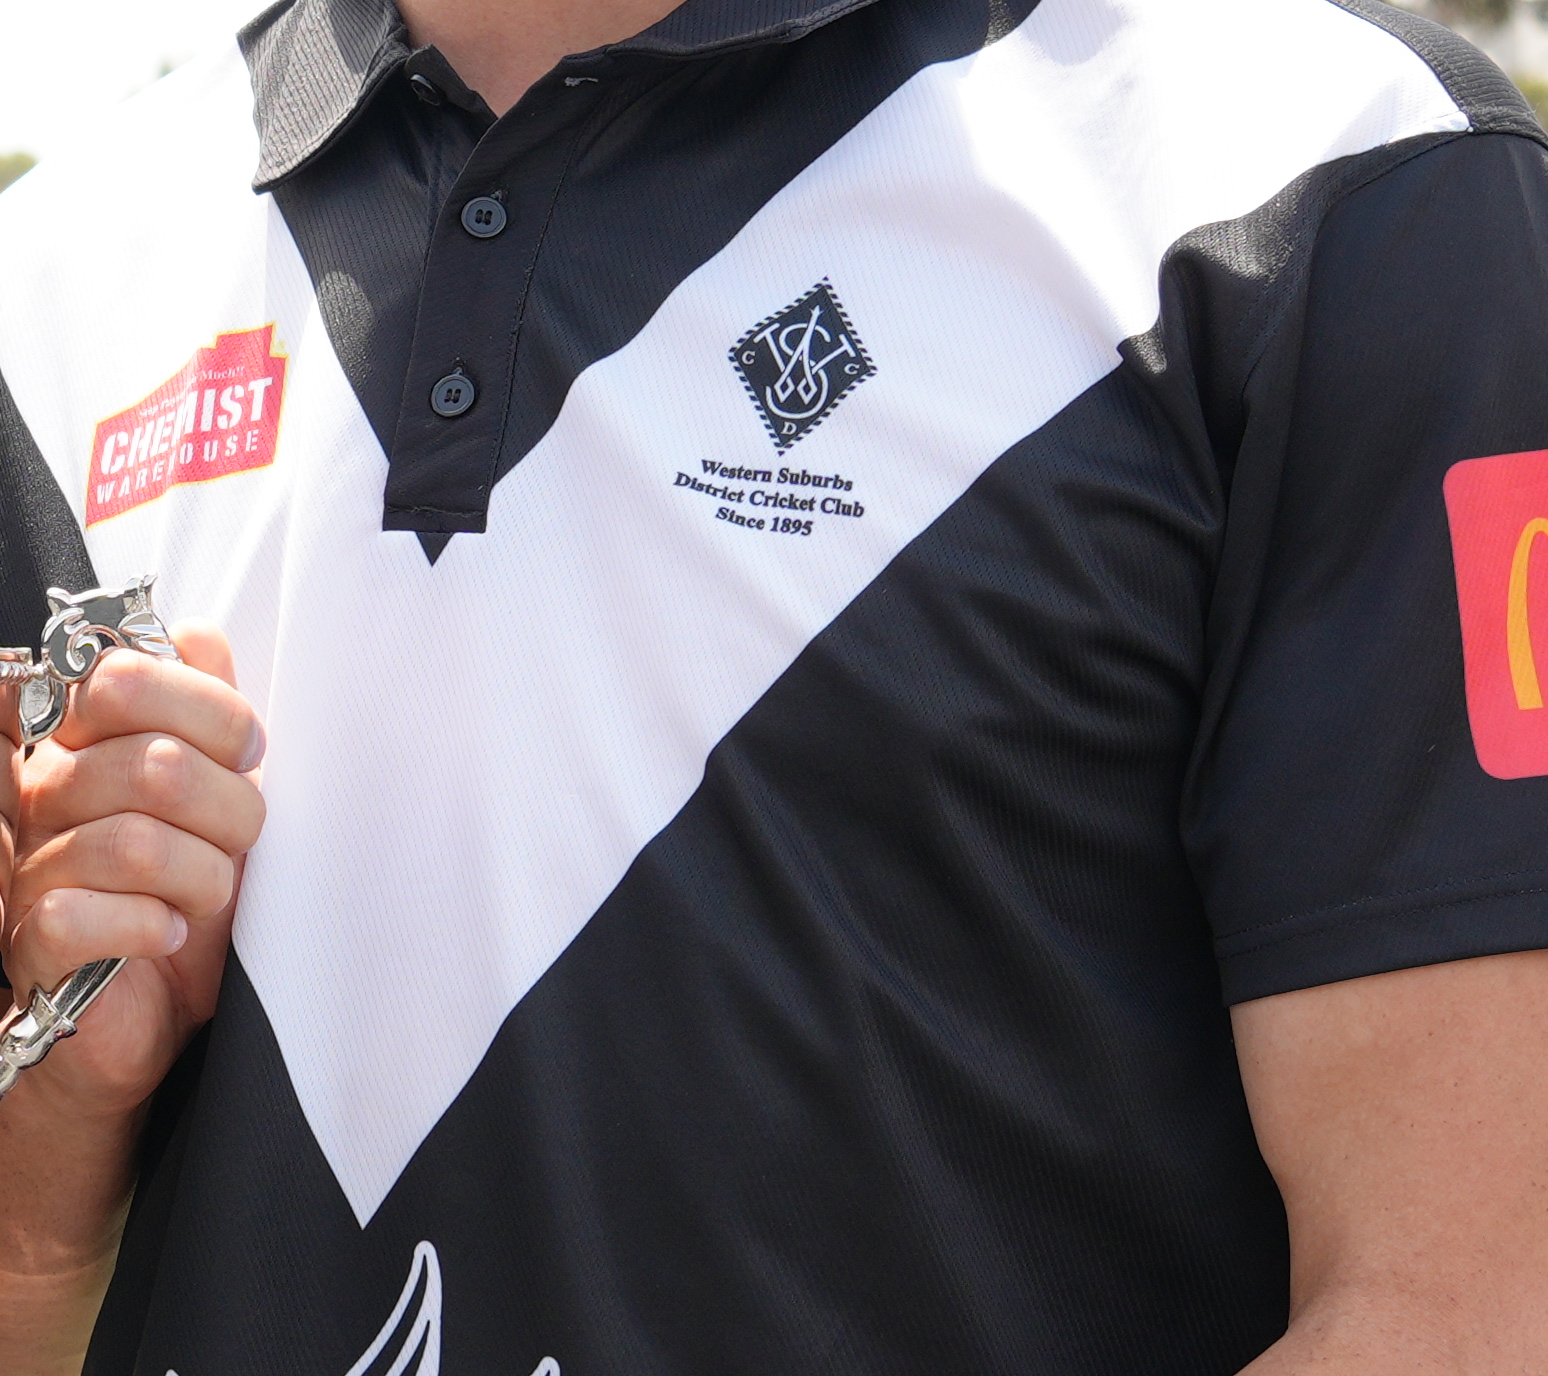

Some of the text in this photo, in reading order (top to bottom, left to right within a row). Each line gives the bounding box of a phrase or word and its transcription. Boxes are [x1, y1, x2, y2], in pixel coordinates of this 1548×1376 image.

[100, 377, 273, 474] CHEMIST
[781, 422, 797, 435] D
[701, 459, 853, 491] Western Suburbs
[673, 472, 865, 518] District Cricket Club
[715, 506, 814, 536] Since 1895
